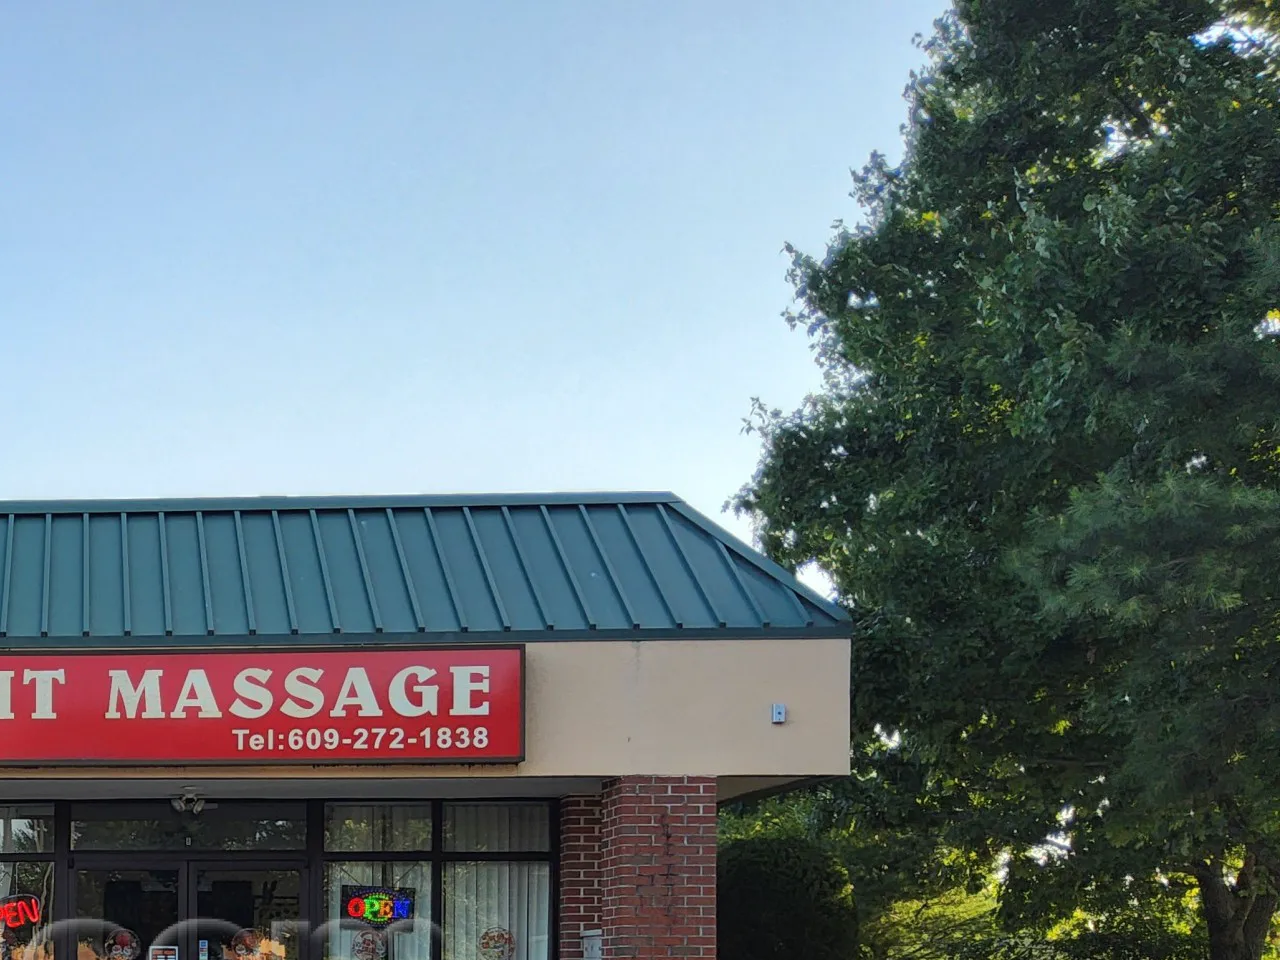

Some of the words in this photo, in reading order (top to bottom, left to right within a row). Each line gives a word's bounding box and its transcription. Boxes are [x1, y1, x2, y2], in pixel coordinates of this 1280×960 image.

[105, 664, 490, 719] MASSAGE
[232, 726, 489, 751] Tel:609-272-1838
[347, 896, 411, 918] OPEN
